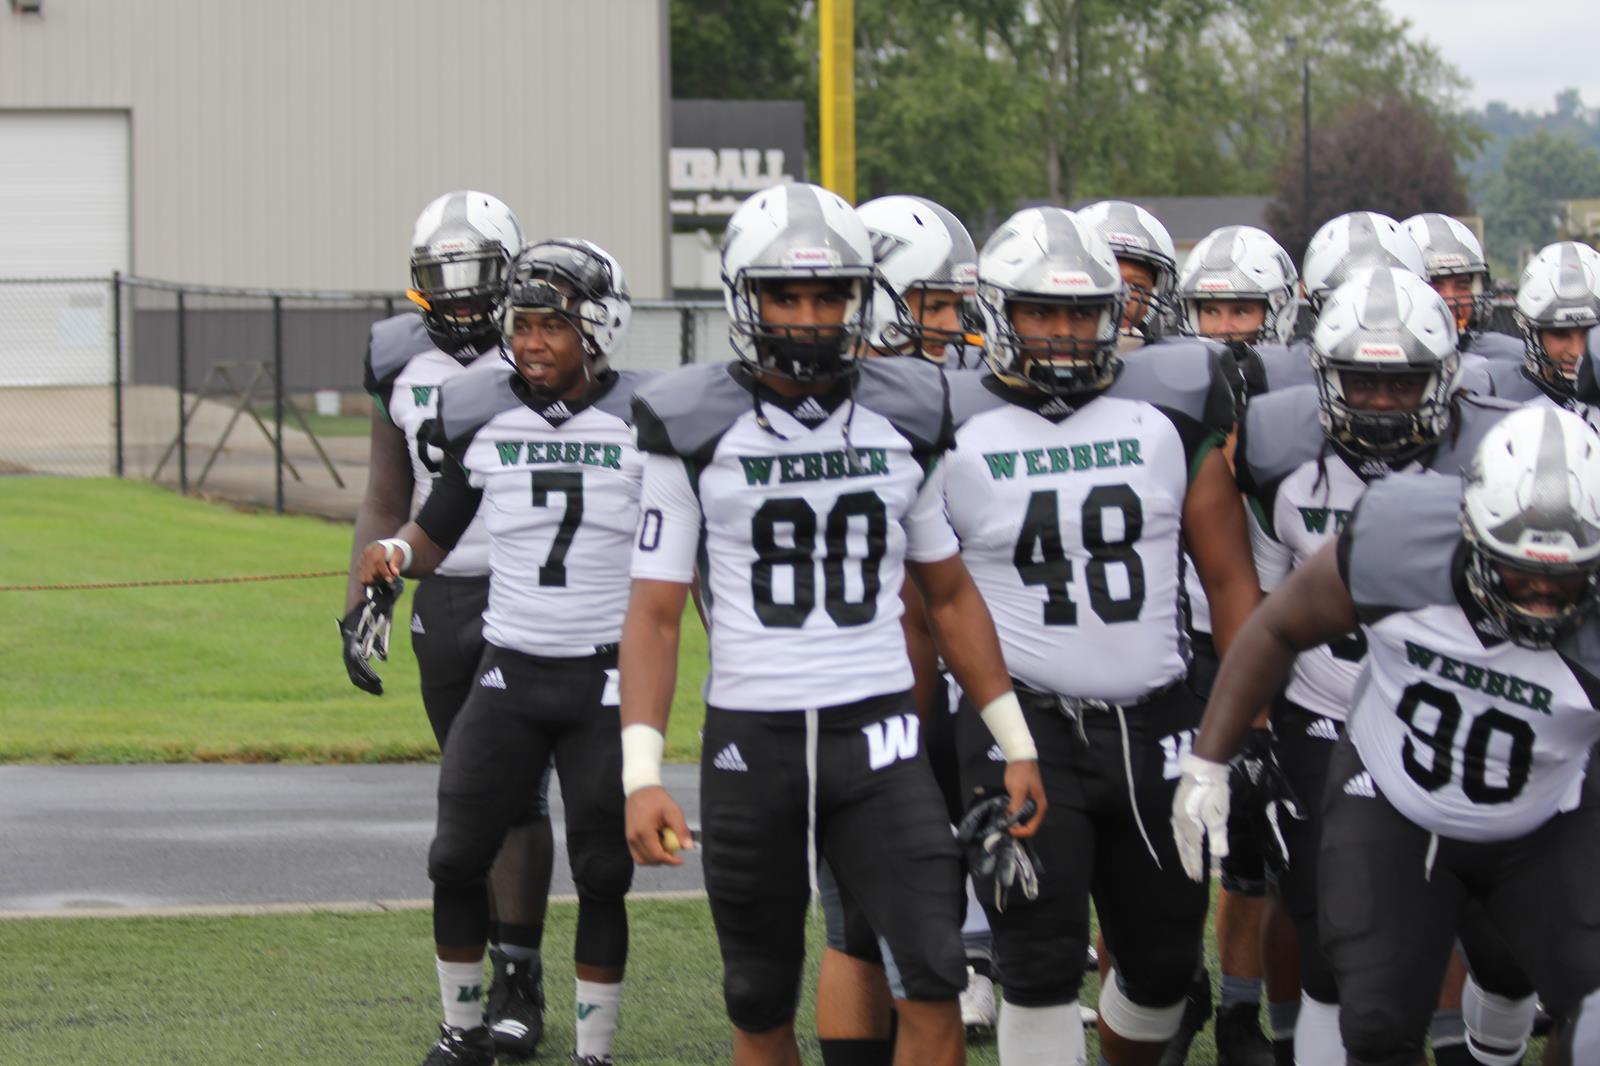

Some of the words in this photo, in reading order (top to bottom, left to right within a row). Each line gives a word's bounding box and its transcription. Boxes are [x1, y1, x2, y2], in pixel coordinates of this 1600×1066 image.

[495, 441, 622, 470] WEBBER
[738, 447, 890, 486] WEBBER
[983, 438, 1144, 480] WEBBER
[530, 470, 584, 587] 7
[751, 490, 888, 629] 80
[1013, 482, 1146, 626] 48
[1404, 639, 1553, 716] WEBBER
[861, 712, 921, 771] W
[1396, 680, 1537, 805] 90
